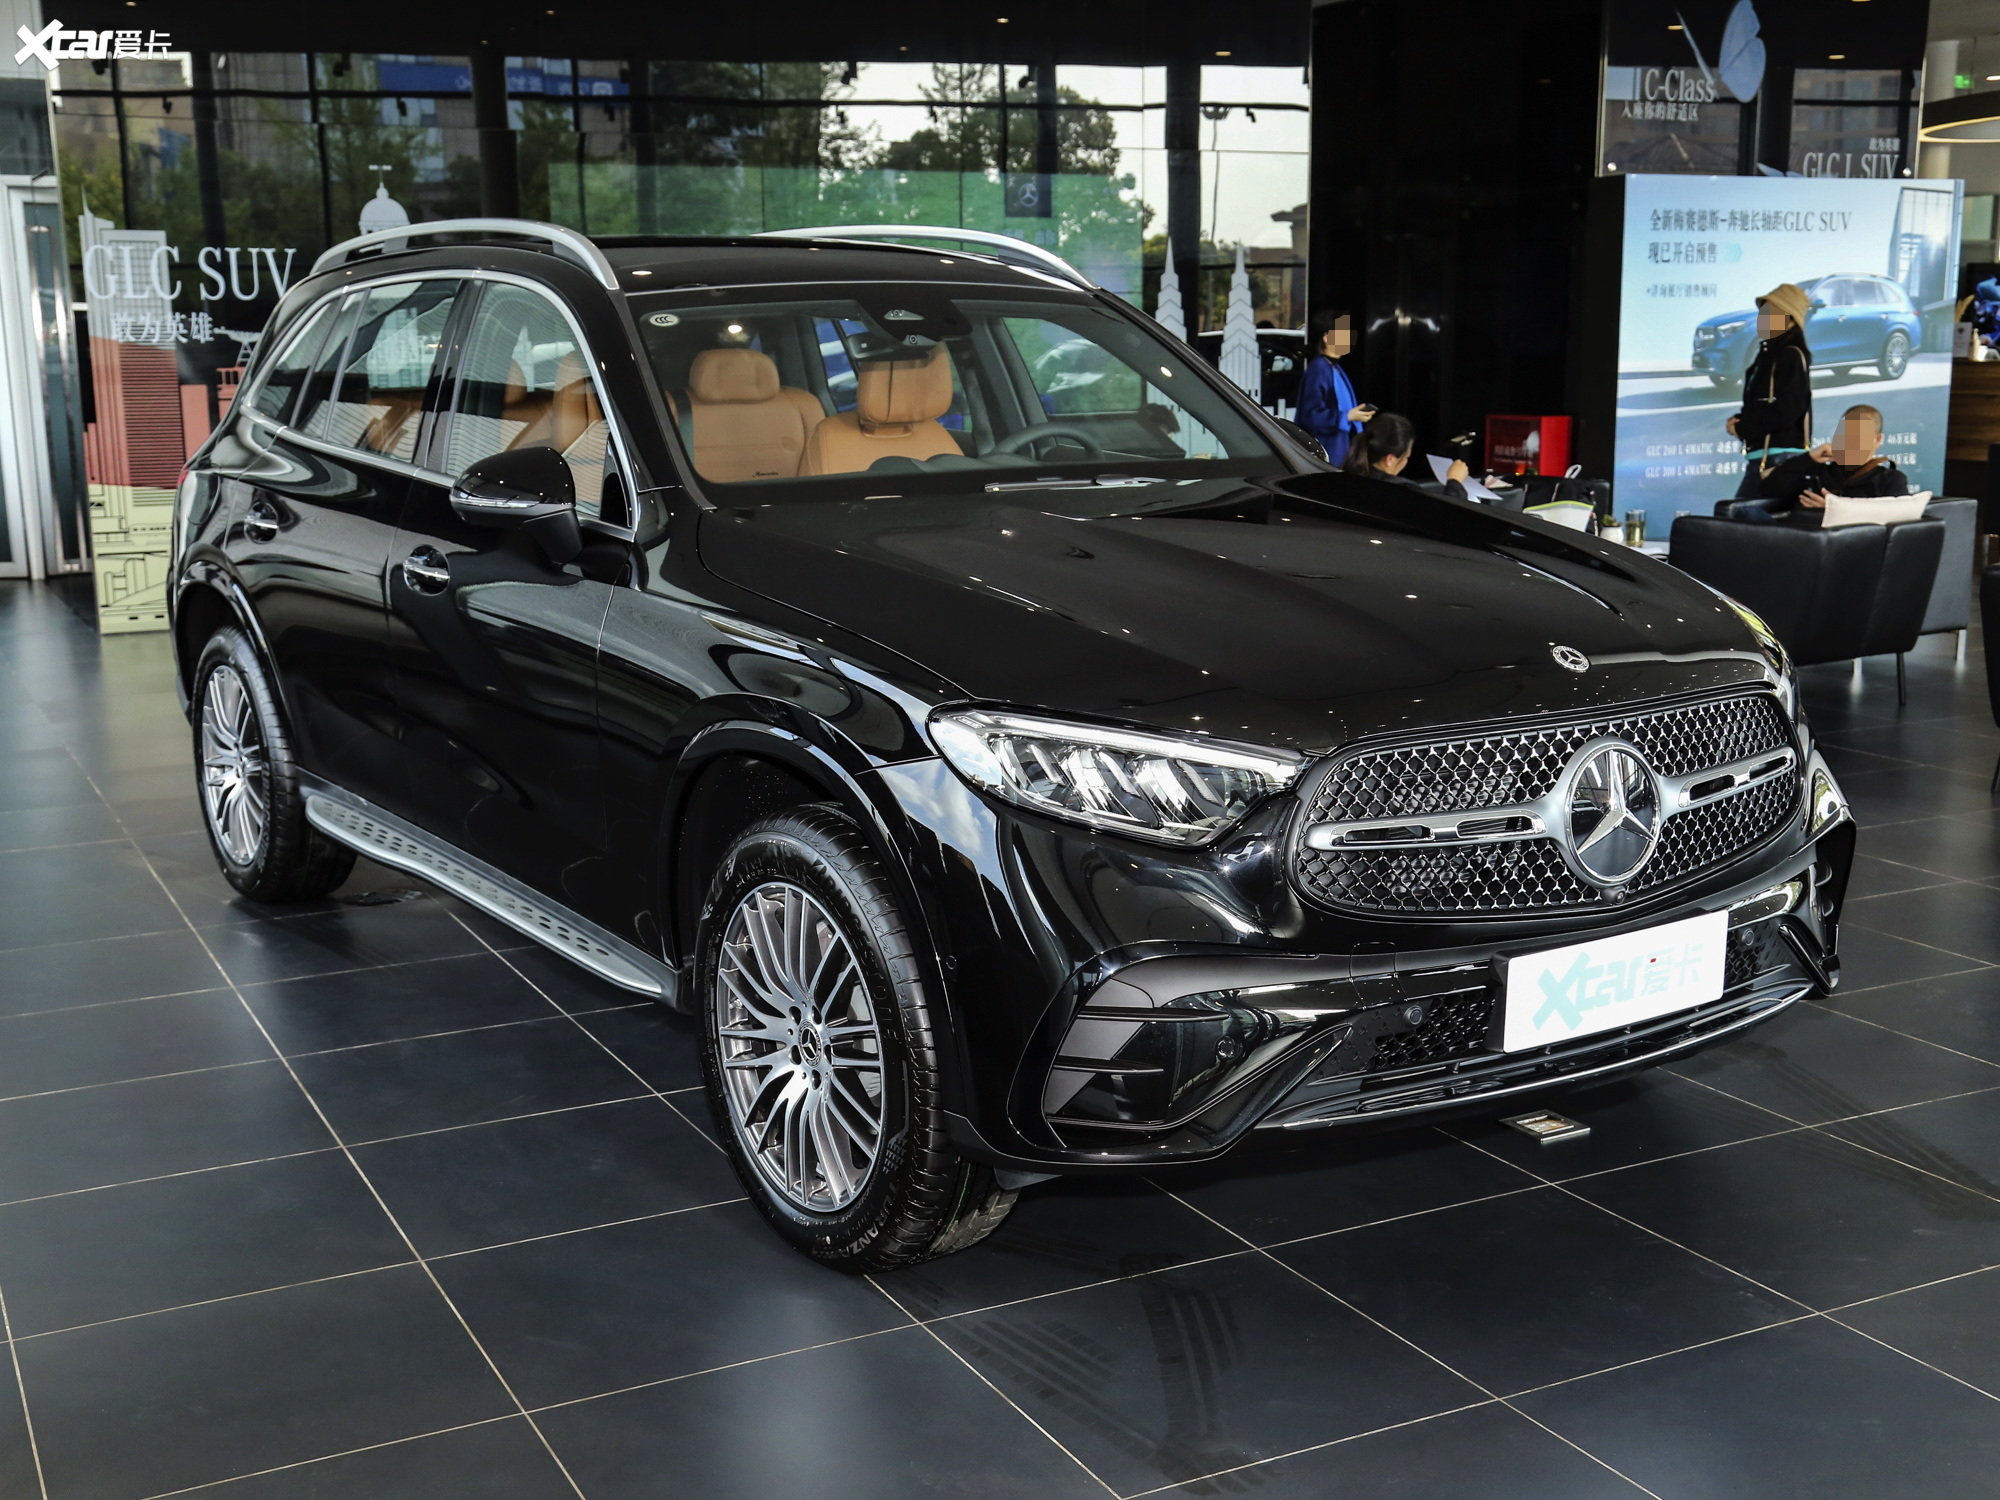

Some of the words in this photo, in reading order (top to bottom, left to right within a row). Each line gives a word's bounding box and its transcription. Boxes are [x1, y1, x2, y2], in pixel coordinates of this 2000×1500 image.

[1645, 68, 1714, 103] C-Class
[1819, 211, 1852, 232] SUV
[83, 244, 182, 300] GLC
[197, 246, 297, 301] SUV
[110, 311, 215, 344] 敢为英雄
